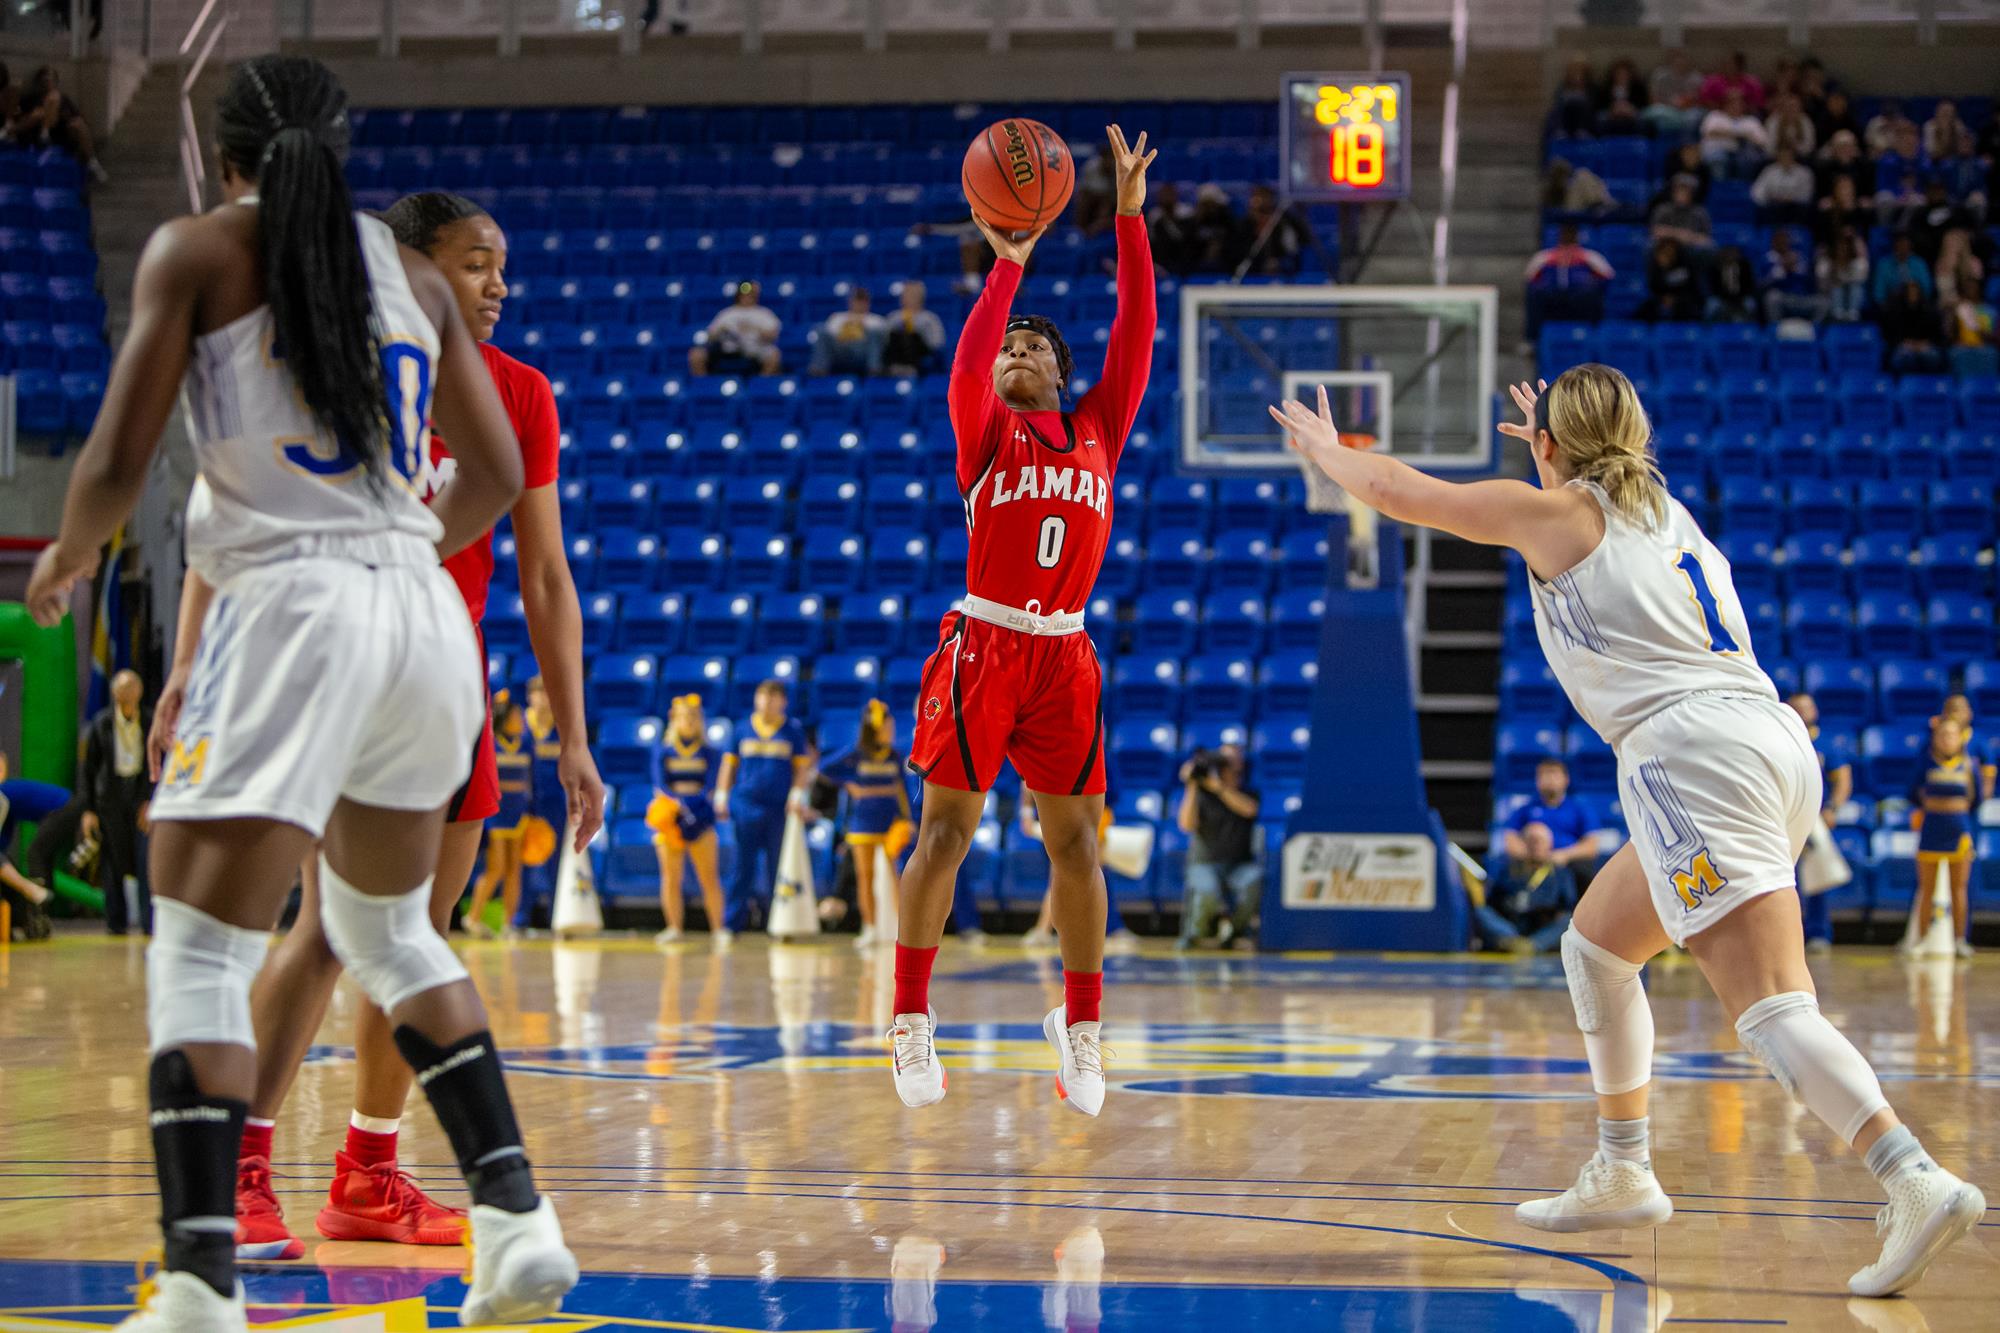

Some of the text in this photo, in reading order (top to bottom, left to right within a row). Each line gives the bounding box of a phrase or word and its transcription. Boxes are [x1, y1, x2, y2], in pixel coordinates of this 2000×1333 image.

[1002, 121, 1035, 188] Wilson
[1329, 123, 1385, 189] 18
[991, 465, 1107, 520] LAMAR
[1036, 514, 1067, 569] 0
[1671, 547, 1744, 656] 1
[165, 735, 210, 786] M
[1669, 847, 1728, 913] M
